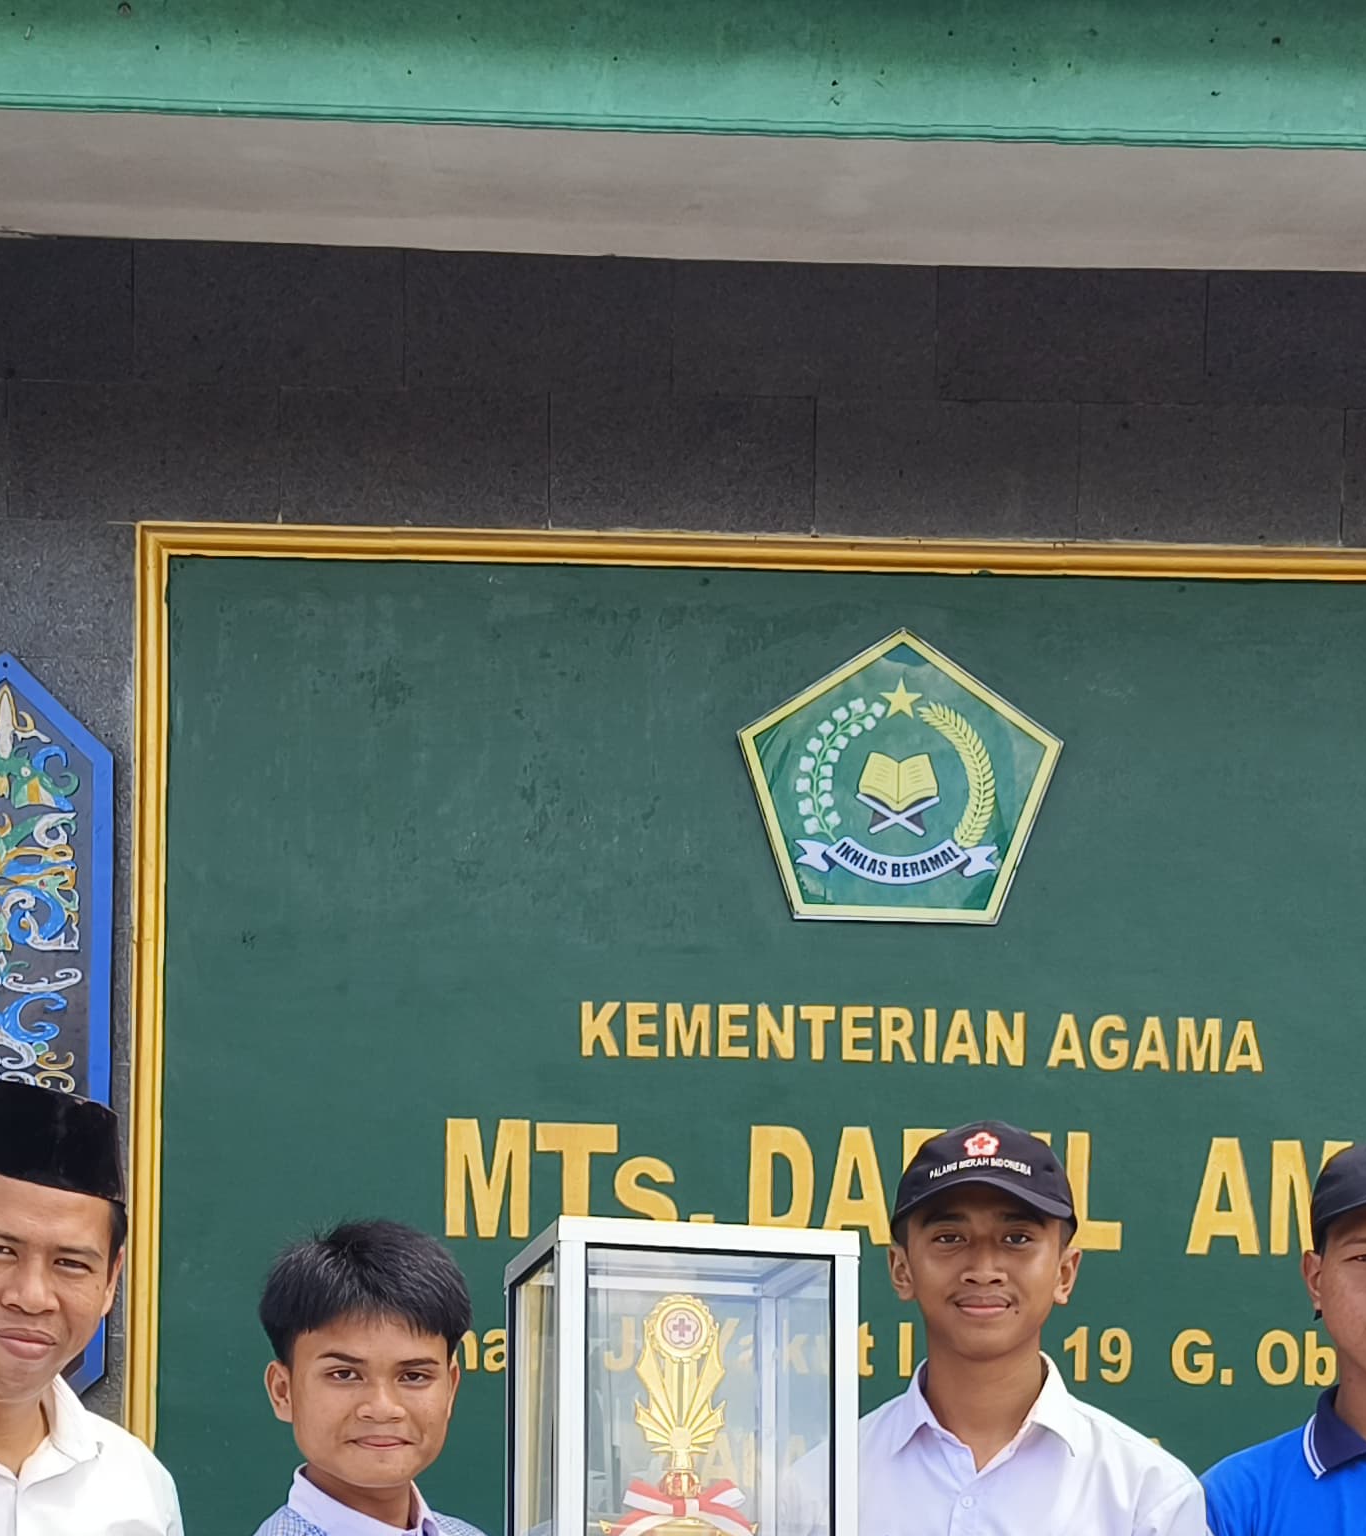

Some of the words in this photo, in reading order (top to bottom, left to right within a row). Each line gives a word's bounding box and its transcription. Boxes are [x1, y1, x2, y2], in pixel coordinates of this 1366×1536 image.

[835, 841, 888, 878] IKHLAS
[891, 844, 962, 879] BERAMAL
[579, 1001, 1027, 1068] KEMENTERIAN
[1046, 1012, 1264, 1073] AGAMA
[747, 1124, 1122, 1251] DAL
[929, 1161, 958, 1179] PALANG
[959, 1157, 989, 1169] MERAH
[990, 1157, 1032, 1177] INDONESIA
[1062, 1326, 1133, 1385] 19
[1171, 1328, 1235, 1386] G.
[1256, 1329, 1337, 1388] Ob
